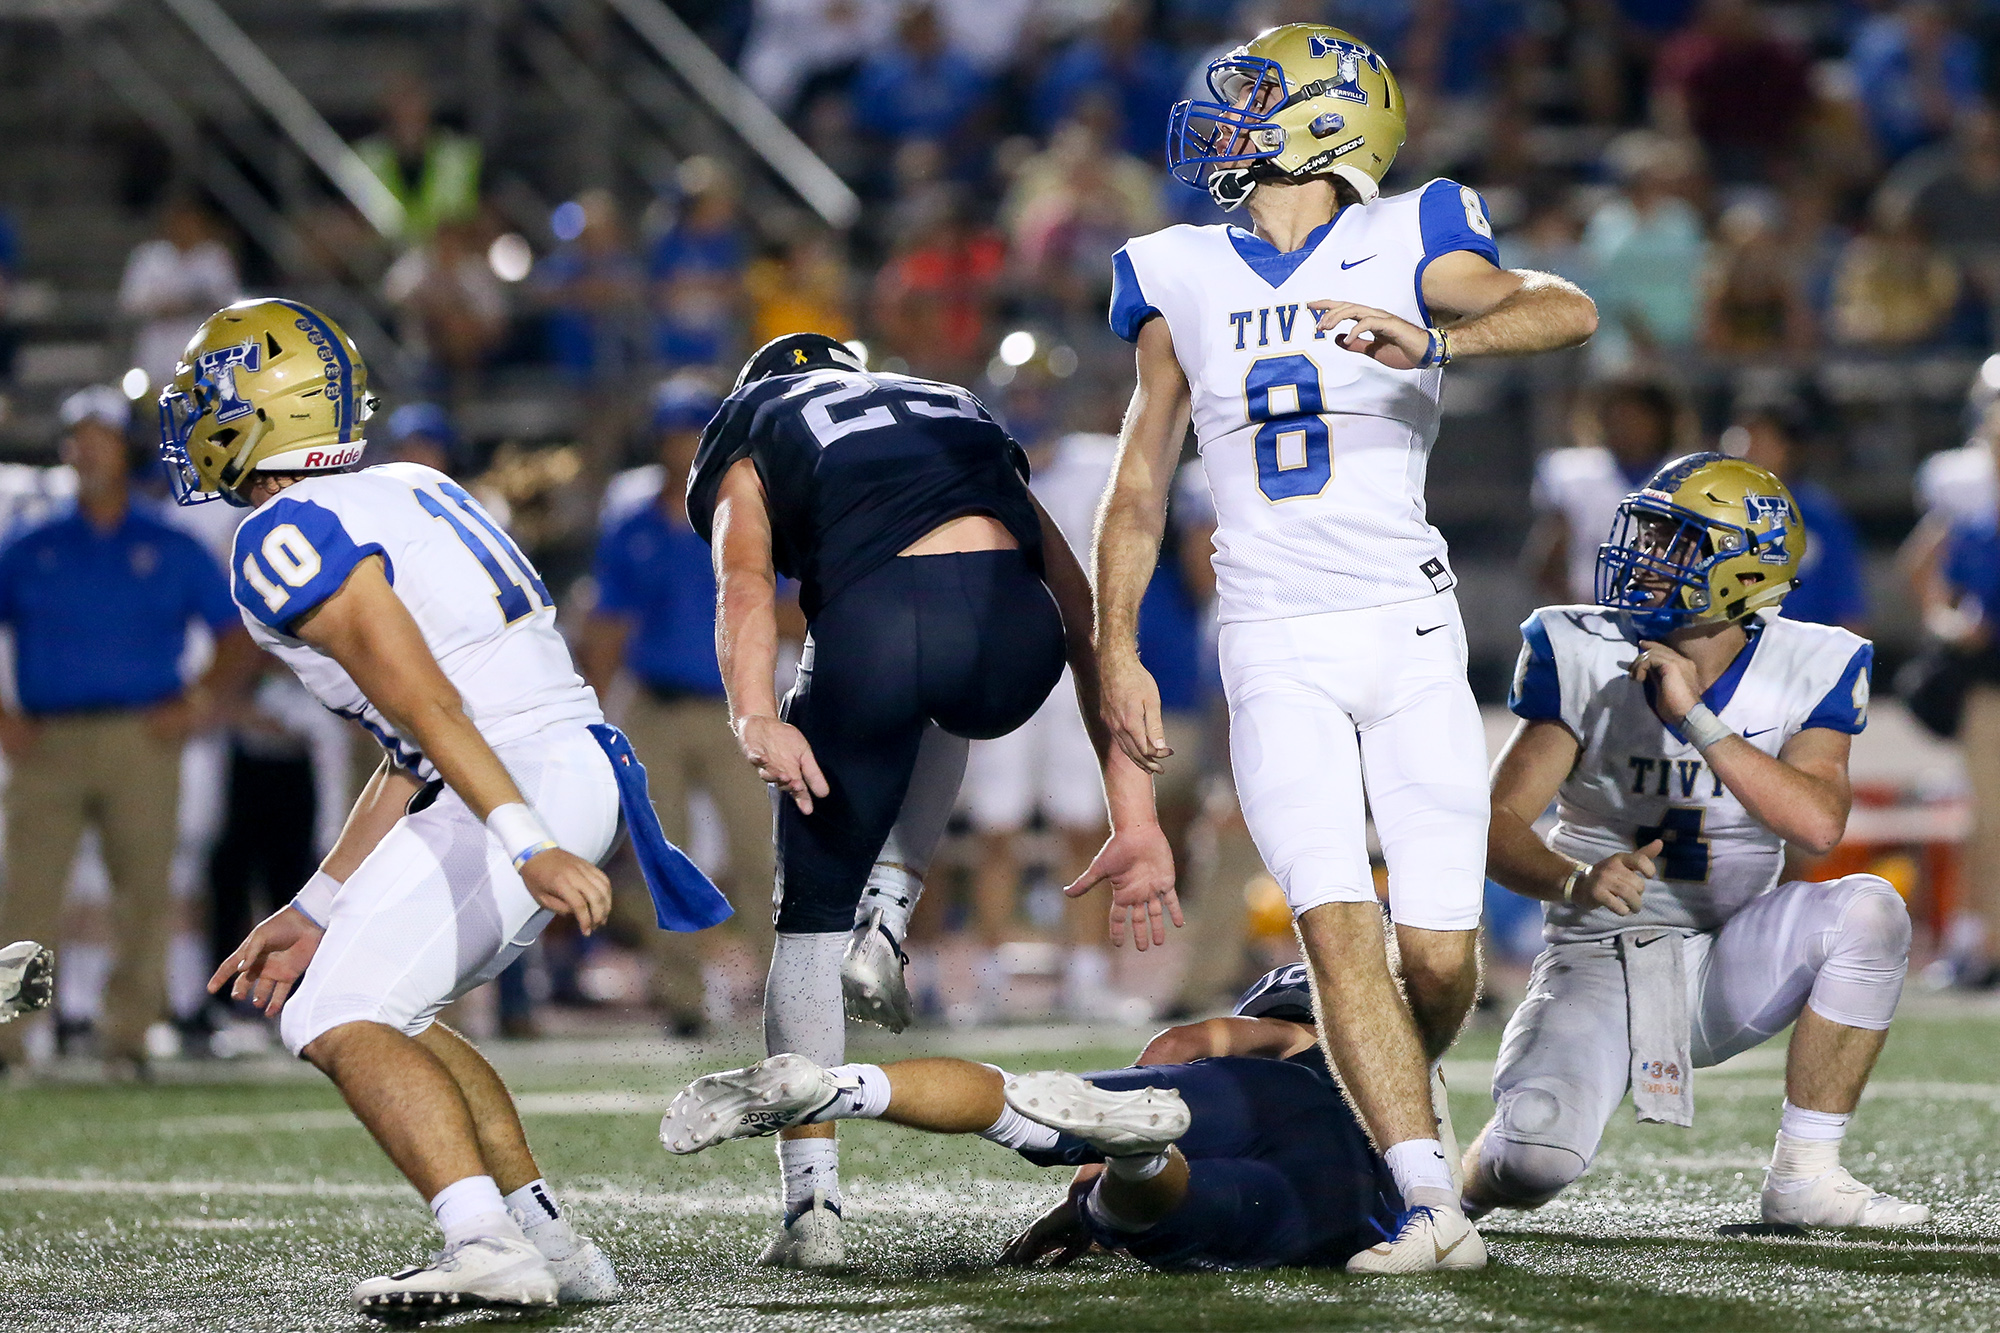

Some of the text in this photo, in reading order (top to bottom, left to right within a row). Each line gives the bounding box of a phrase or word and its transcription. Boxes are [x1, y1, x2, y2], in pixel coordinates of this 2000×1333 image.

[1459, 185, 1492, 240] 8
[1228, 302, 1328, 352] TIVY
[326, 386, 341, 397] 212
[1242, 350, 1335, 505] 8
[305, 448, 361, 467] Ridde
[243, 523, 322, 614] 10
[1427, 562, 1439, 574] M
[1852, 666, 1870, 725] 4
[1634, 806, 1712, 885] 4
[740, 1110, 794, 1125] didas
